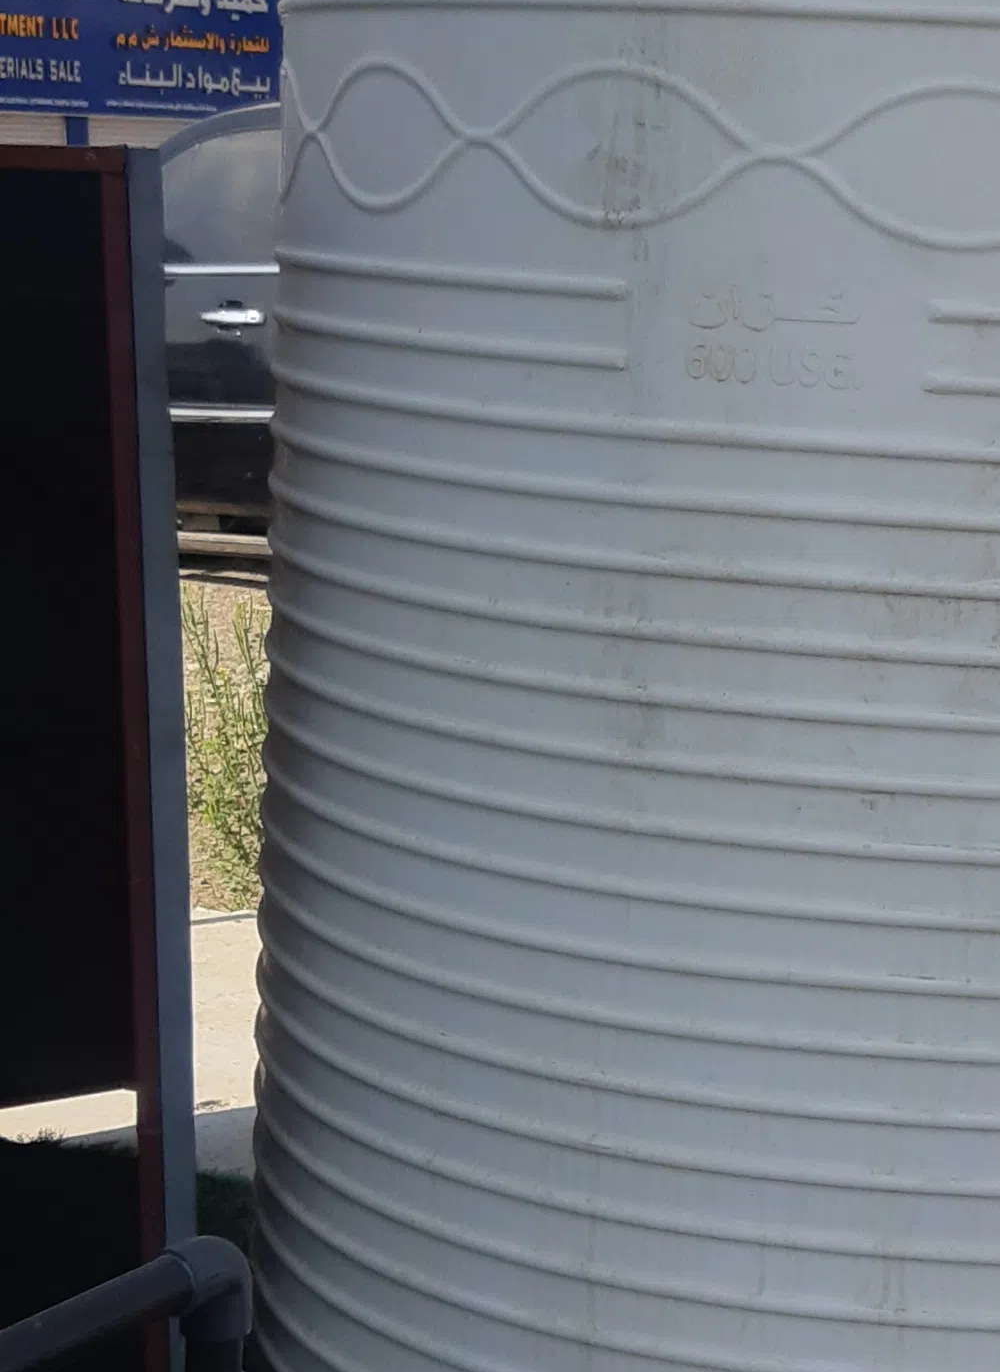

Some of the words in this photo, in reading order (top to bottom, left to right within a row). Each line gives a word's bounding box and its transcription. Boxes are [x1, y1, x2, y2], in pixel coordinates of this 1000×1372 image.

[50, 60, 82, 83] SALE
[118, 60, 183, 96] البناء
[185, 66, 230, 95] مواد
